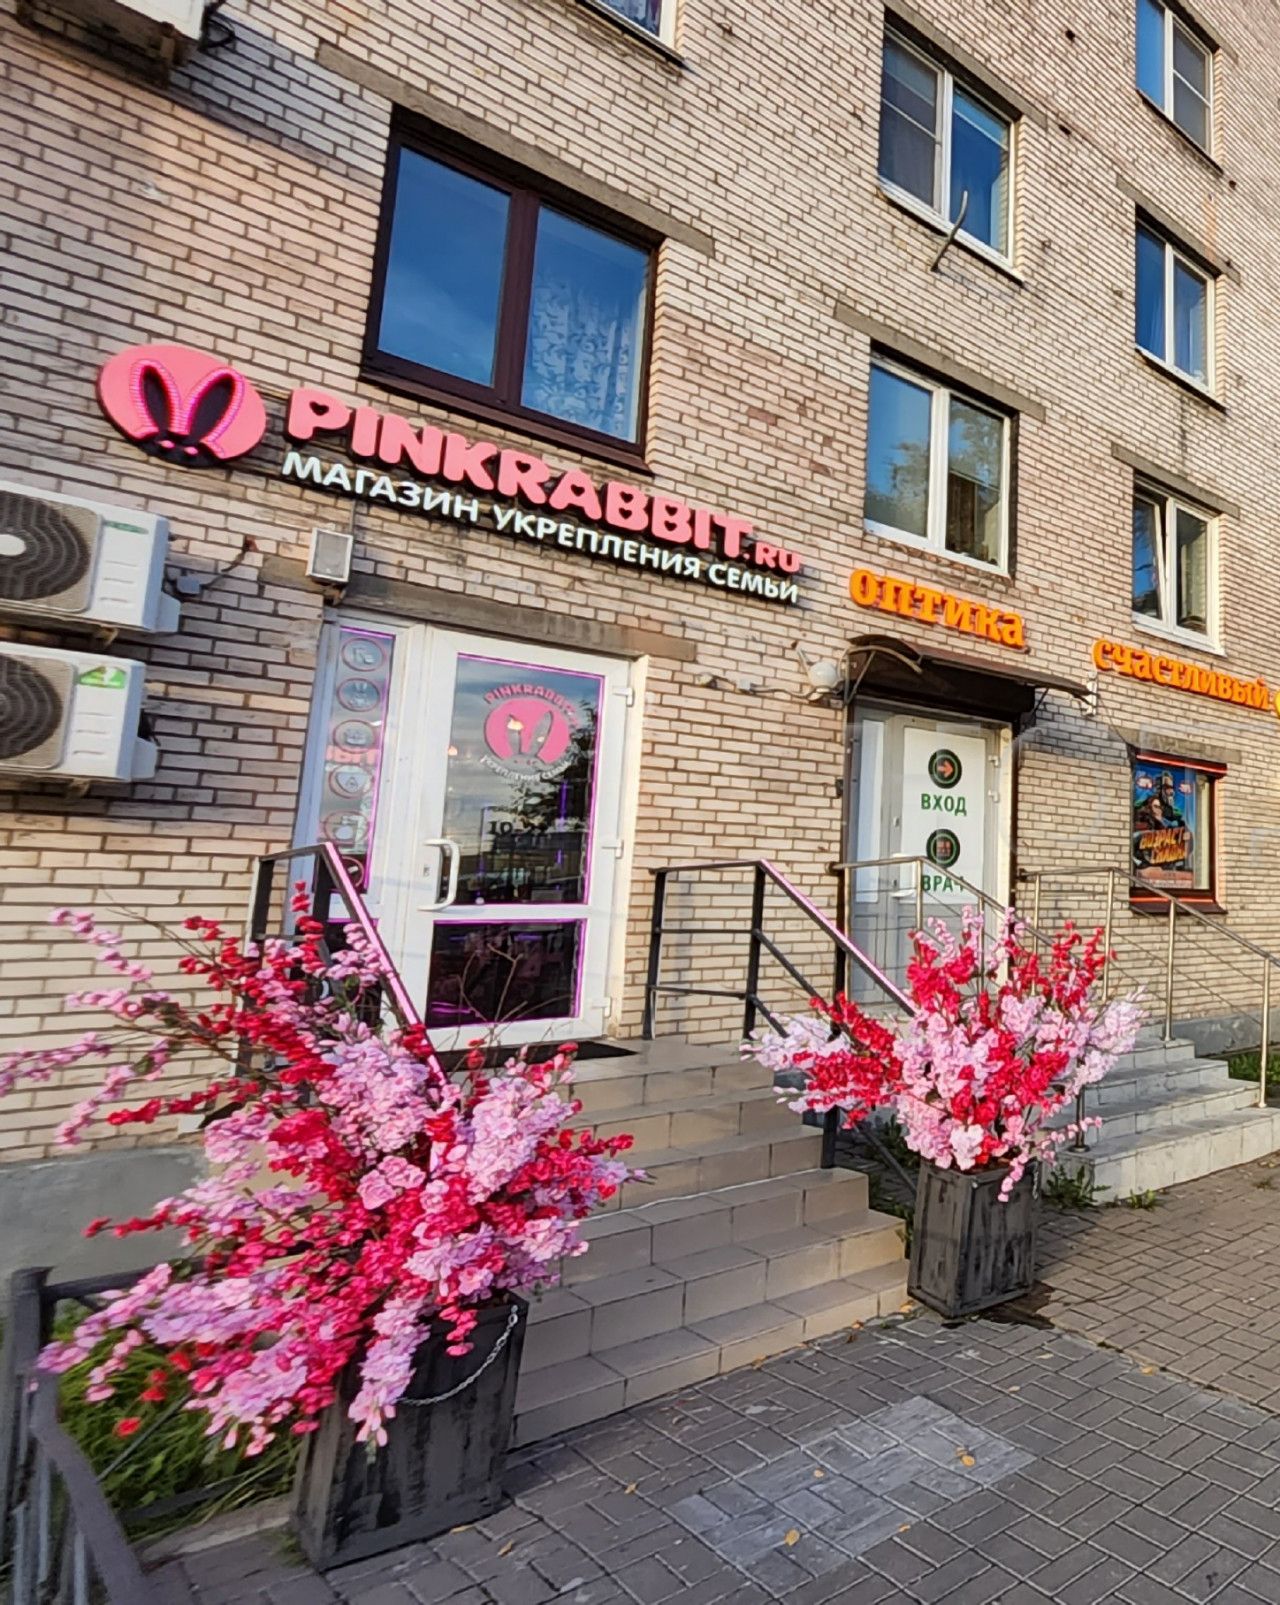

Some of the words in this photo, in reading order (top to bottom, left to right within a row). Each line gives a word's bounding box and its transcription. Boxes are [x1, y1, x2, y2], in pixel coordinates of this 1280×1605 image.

[282, 452, 479, 523] МАГАЗИН
[491, 503, 701, 579] УКРЕПЛЕНИЯ
[708, 563, 799, 604] СЕМЬИ
[288, 388, 801, 573] PINKRABBIT.RU
[921, 793, 967, 817] ВХОД
